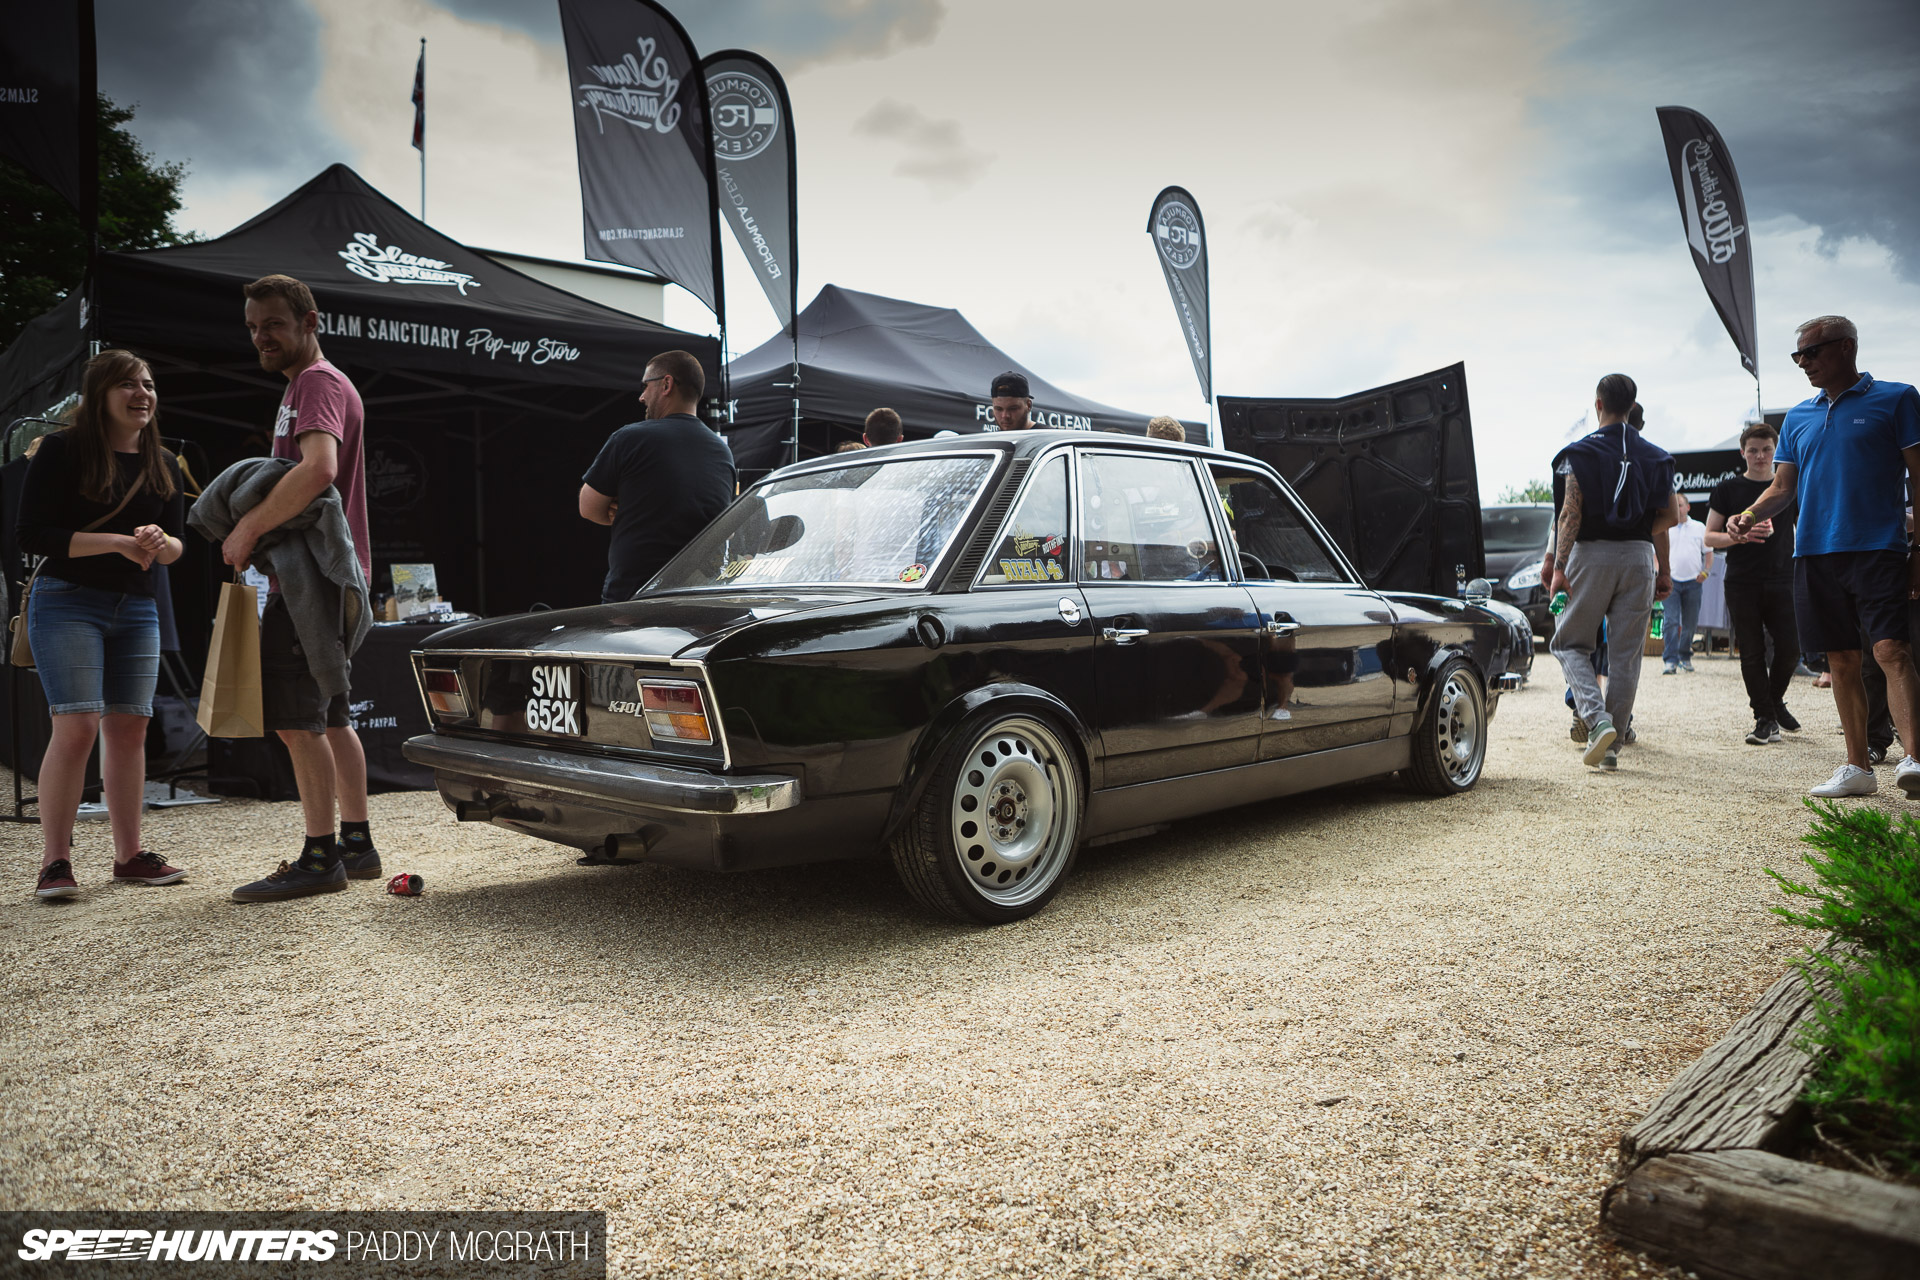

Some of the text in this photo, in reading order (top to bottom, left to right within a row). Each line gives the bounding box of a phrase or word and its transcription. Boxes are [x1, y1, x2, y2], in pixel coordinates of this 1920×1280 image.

[346, 232, 453, 270] Slam
[318, 312, 580, 364] SLAM SANCTUARY Pop-up Store
[976, 404, 1092, 431] FOLA CLEAN
[531, 664, 571, 699] SVN
[369, 716, 397, 729] PAYPAL
[526, 698, 579, 735] 652K
